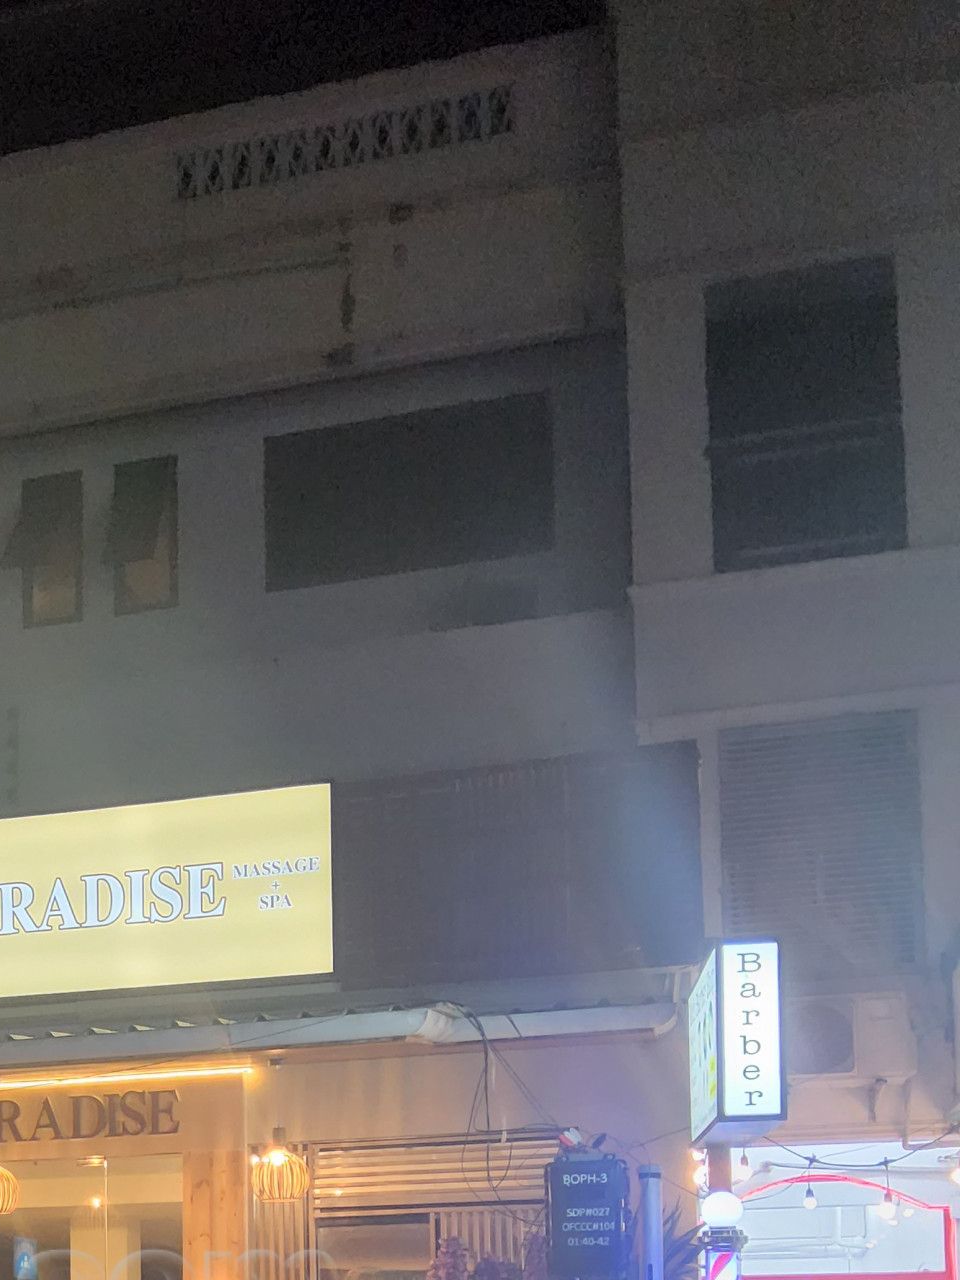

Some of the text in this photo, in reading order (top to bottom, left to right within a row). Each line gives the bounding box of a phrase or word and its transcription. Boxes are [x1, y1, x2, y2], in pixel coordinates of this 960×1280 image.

[233, 856, 320, 878] MASSAGE
[259, 894, 292, 909] SPA
[737, 952, 763, 1106] Barber
[563, 1173, 608, 1187] BOPH-3
